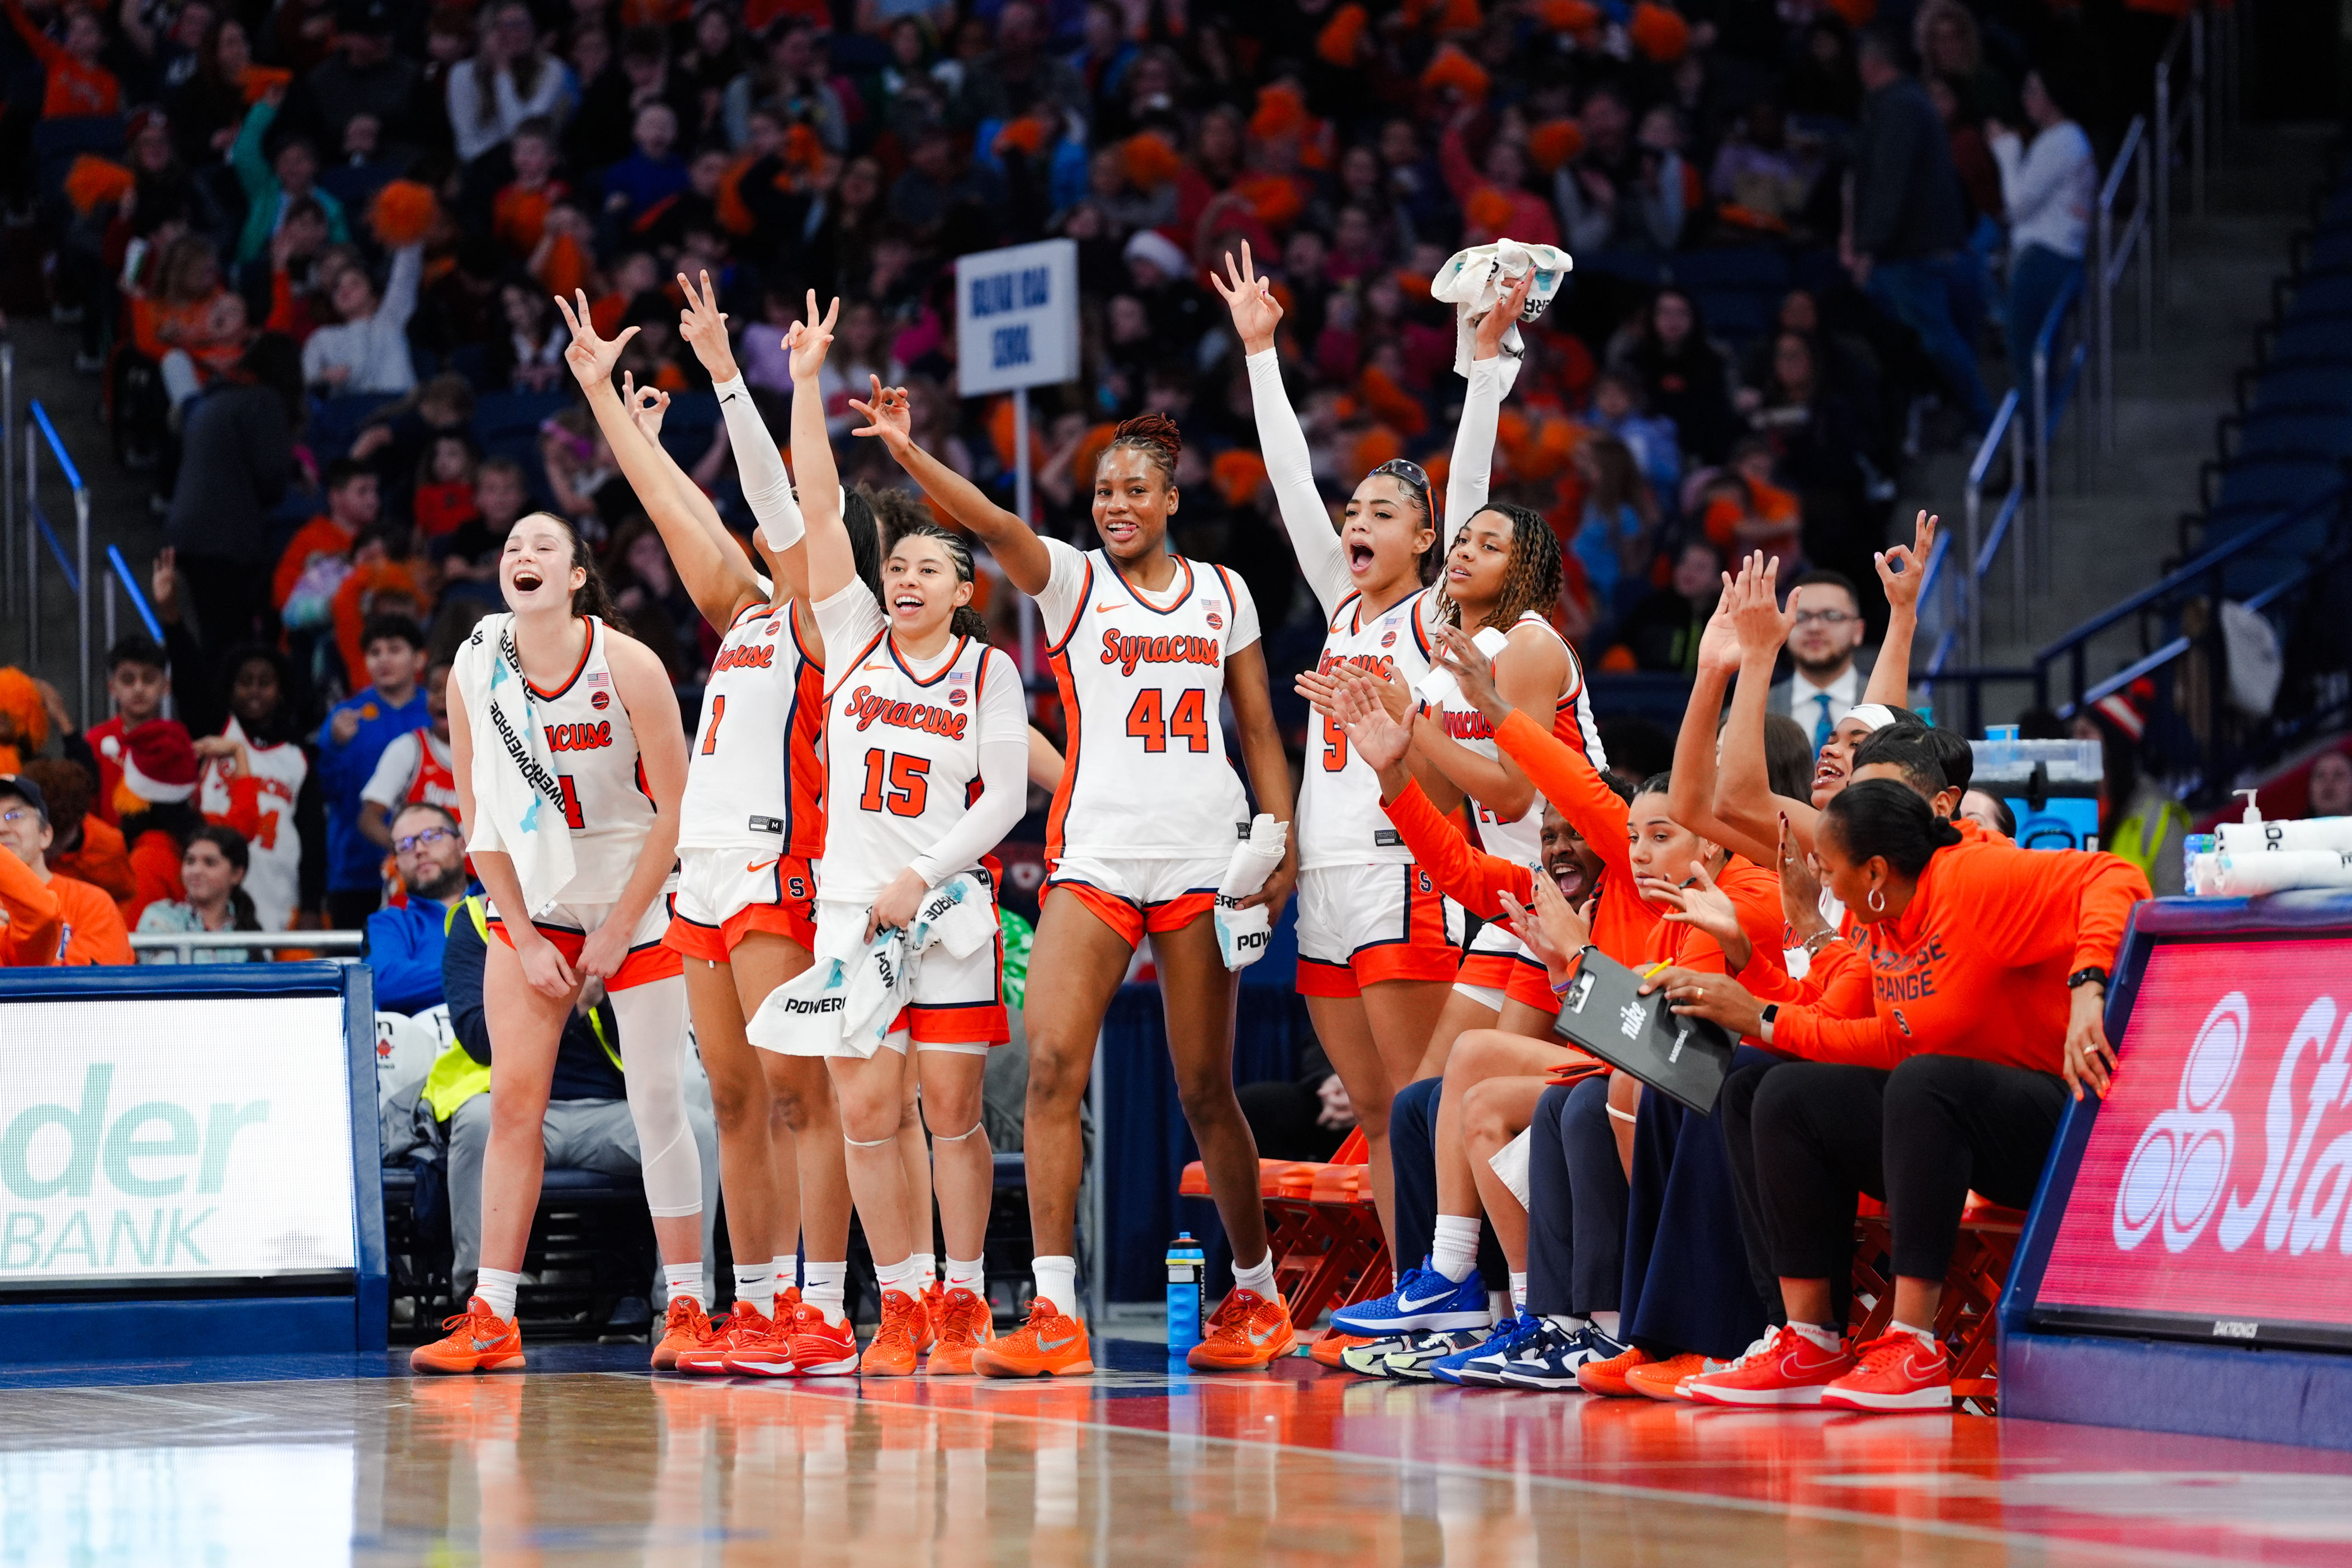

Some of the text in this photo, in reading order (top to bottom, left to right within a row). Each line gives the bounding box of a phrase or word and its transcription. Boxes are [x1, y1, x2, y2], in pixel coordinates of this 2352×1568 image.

[1101, 627, 1220, 677] Syracuse
[702, 695, 725, 755] 1
[844, 686, 967, 741] Syracuse
[1126, 688, 1208, 753] 44
[1323, 716, 1347, 772] 5
[860, 747, 931, 818] 15
[788, 876, 806, 898] S
[1419, 870, 1432, 893] S
[785, 996, 847, 1014] POWER
[1620, 1001, 1647, 1041] nike
[0, 1062, 272, 1201] der
[0, 1207, 219, 1270] BANK
